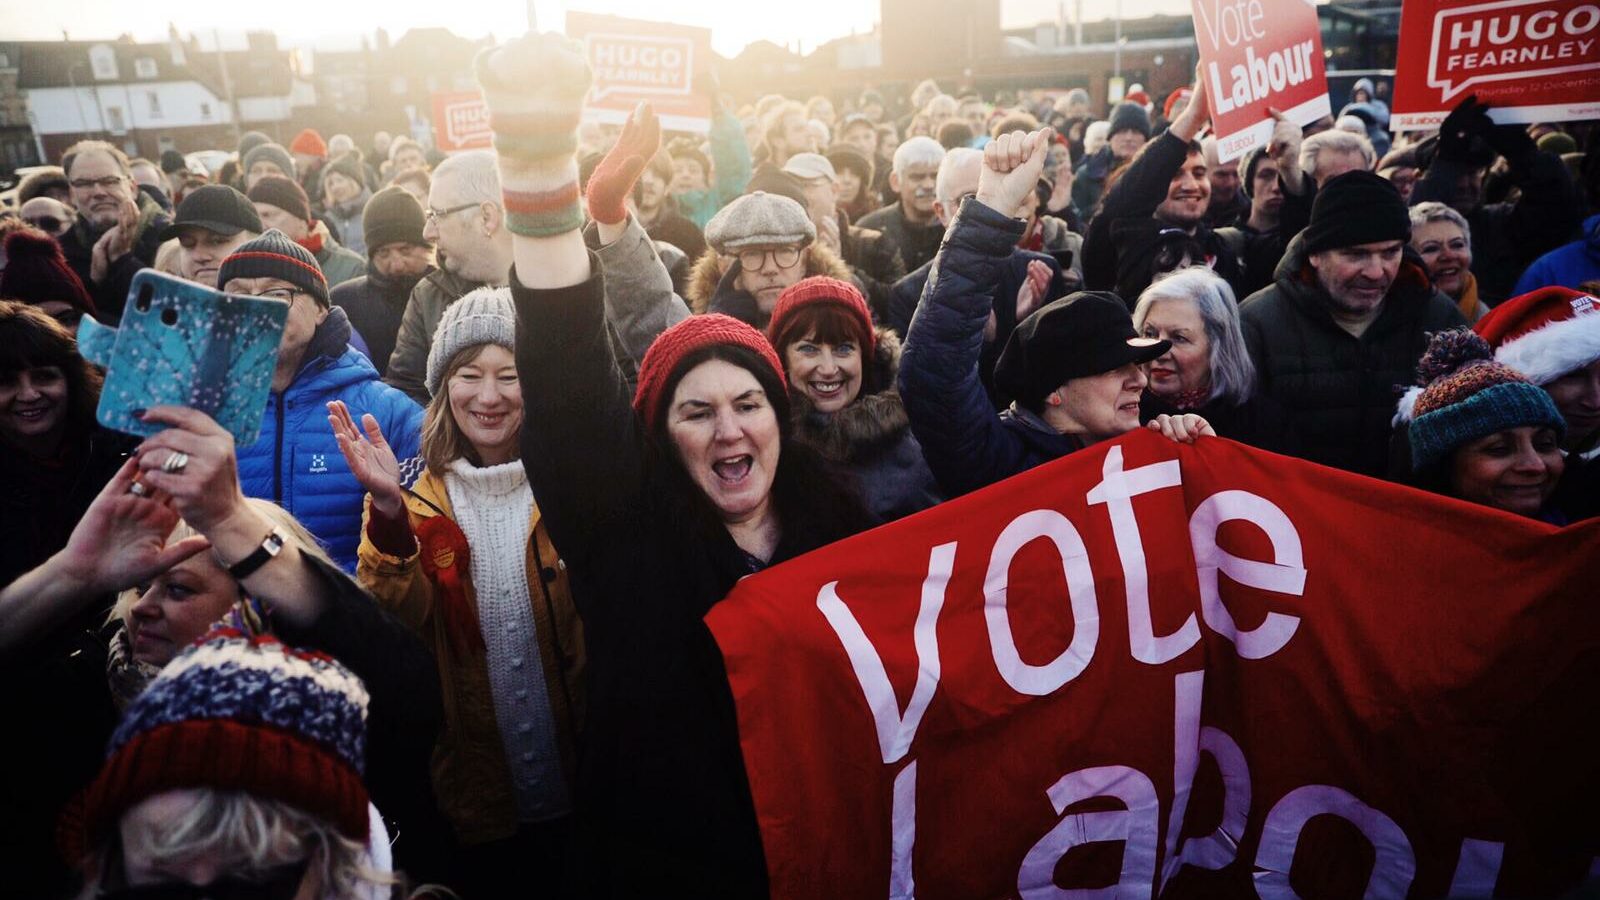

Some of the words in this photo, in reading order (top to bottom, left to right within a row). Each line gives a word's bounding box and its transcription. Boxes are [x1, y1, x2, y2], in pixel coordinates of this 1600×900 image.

[1198, 0, 1266, 51] Vote
[1450, 4, 1600, 50] HUGO
[596, 44, 681, 69] HUGO
[1446, 38, 1594, 72] FEARNLEY
[1209, 39, 1314, 115] Labour
[1475, 83, 1526, 97] Thursday
[453, 107, 490, 124] HUG
[816, 445, 1307, 764] Vote
